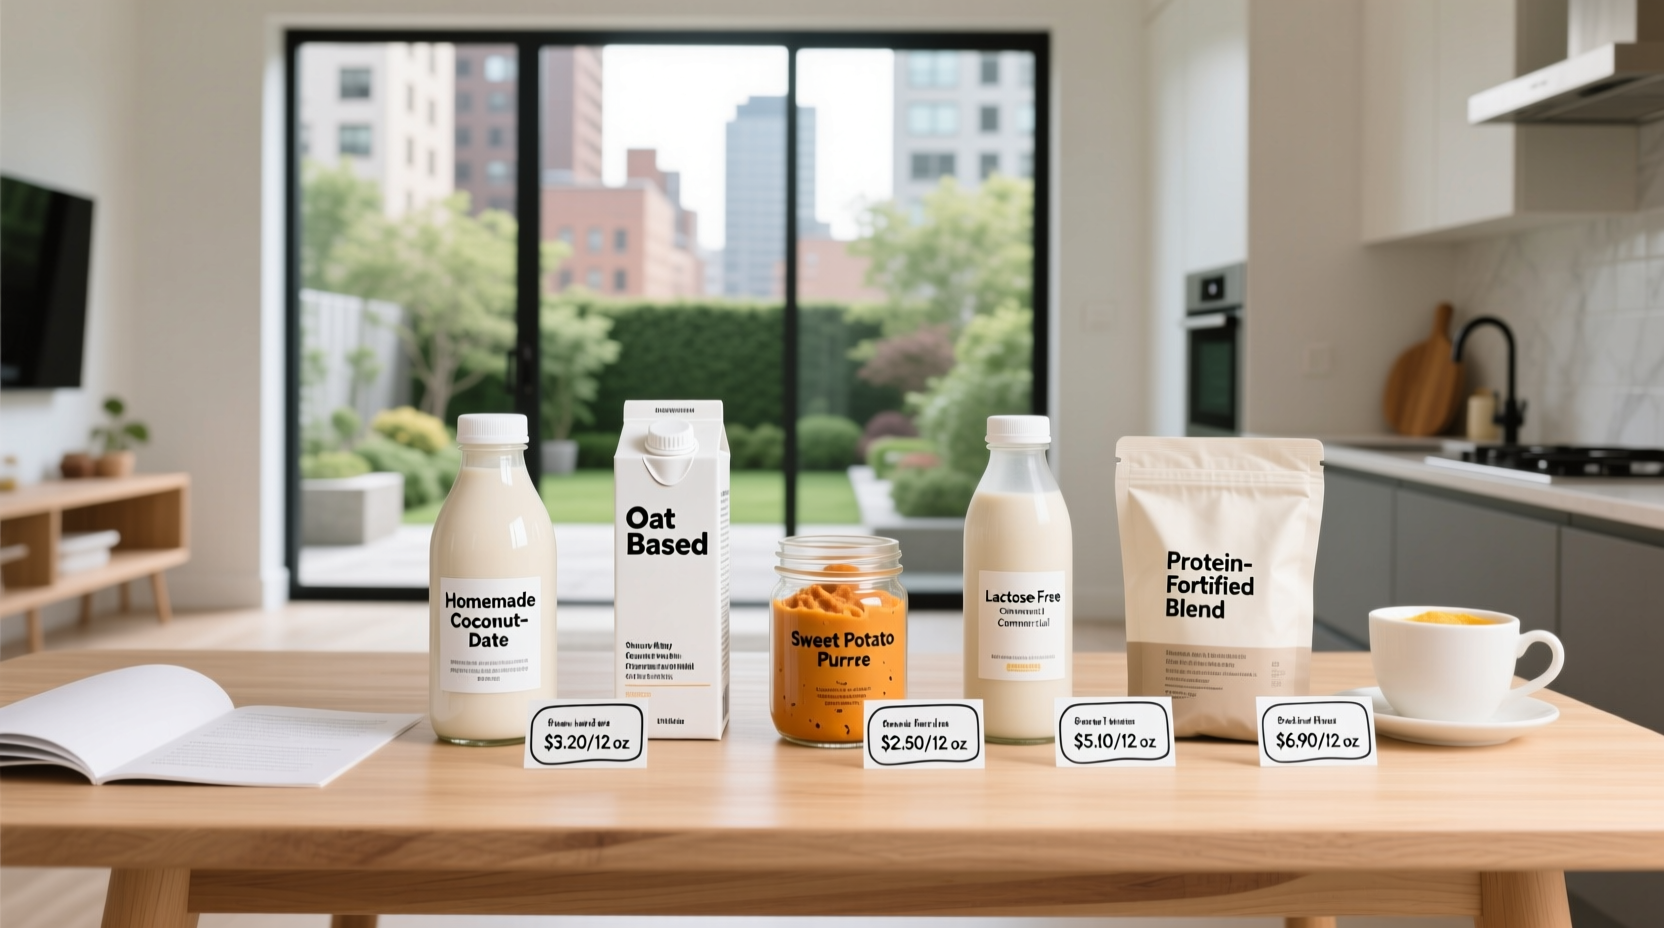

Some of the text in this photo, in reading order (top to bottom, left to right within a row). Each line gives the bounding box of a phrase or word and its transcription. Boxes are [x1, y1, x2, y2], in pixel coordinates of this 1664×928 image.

[626, 506, 676, 529] Oat
[627, 532, 708, 555] Based
[1167, 551, 1253, 572] Protein-
[1166, 575, 1254, 595] Fortified
[445, 591, 536, 608] Homemade
[1166, 598, 1225, 619] Blend
[450, 612, 529, 628] Coconut-
[469, 632, 509, 648] Date
[791, 631, 895, 648] Sweet Potato
[544, 733, 630, 752] $3.20/12 oz
[881, 734, 968, 753] $2.50/12 oz
[1074, 732, 1157, 751] $5.10/12 oz
[1276, 731, 1360, 751] $6.90/12 oz
